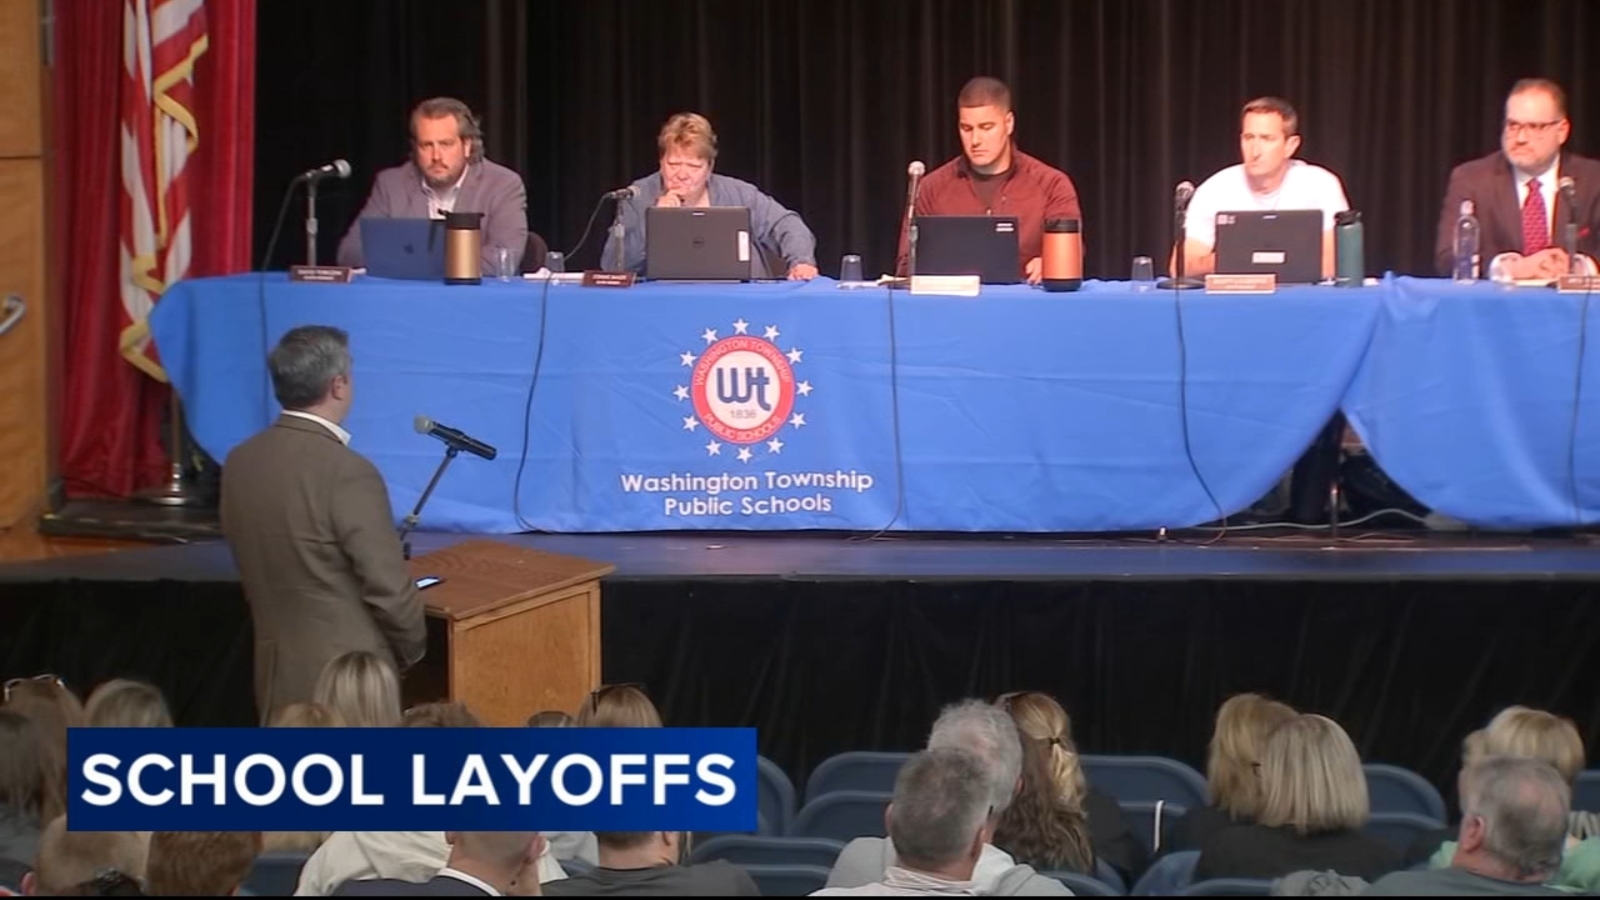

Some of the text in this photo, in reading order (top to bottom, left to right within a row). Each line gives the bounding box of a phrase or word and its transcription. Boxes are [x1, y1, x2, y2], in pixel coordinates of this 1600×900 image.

[694, 339, 791, 386] WASHINGTON TOWNSHIP
[730, 409, 758, 419] 1836
[703, 413, 781, 440] PUBLIC SCHOOLS
[621, 470, 873, 494] Washington Township
[665, 494, 832, 515] Public Schools
